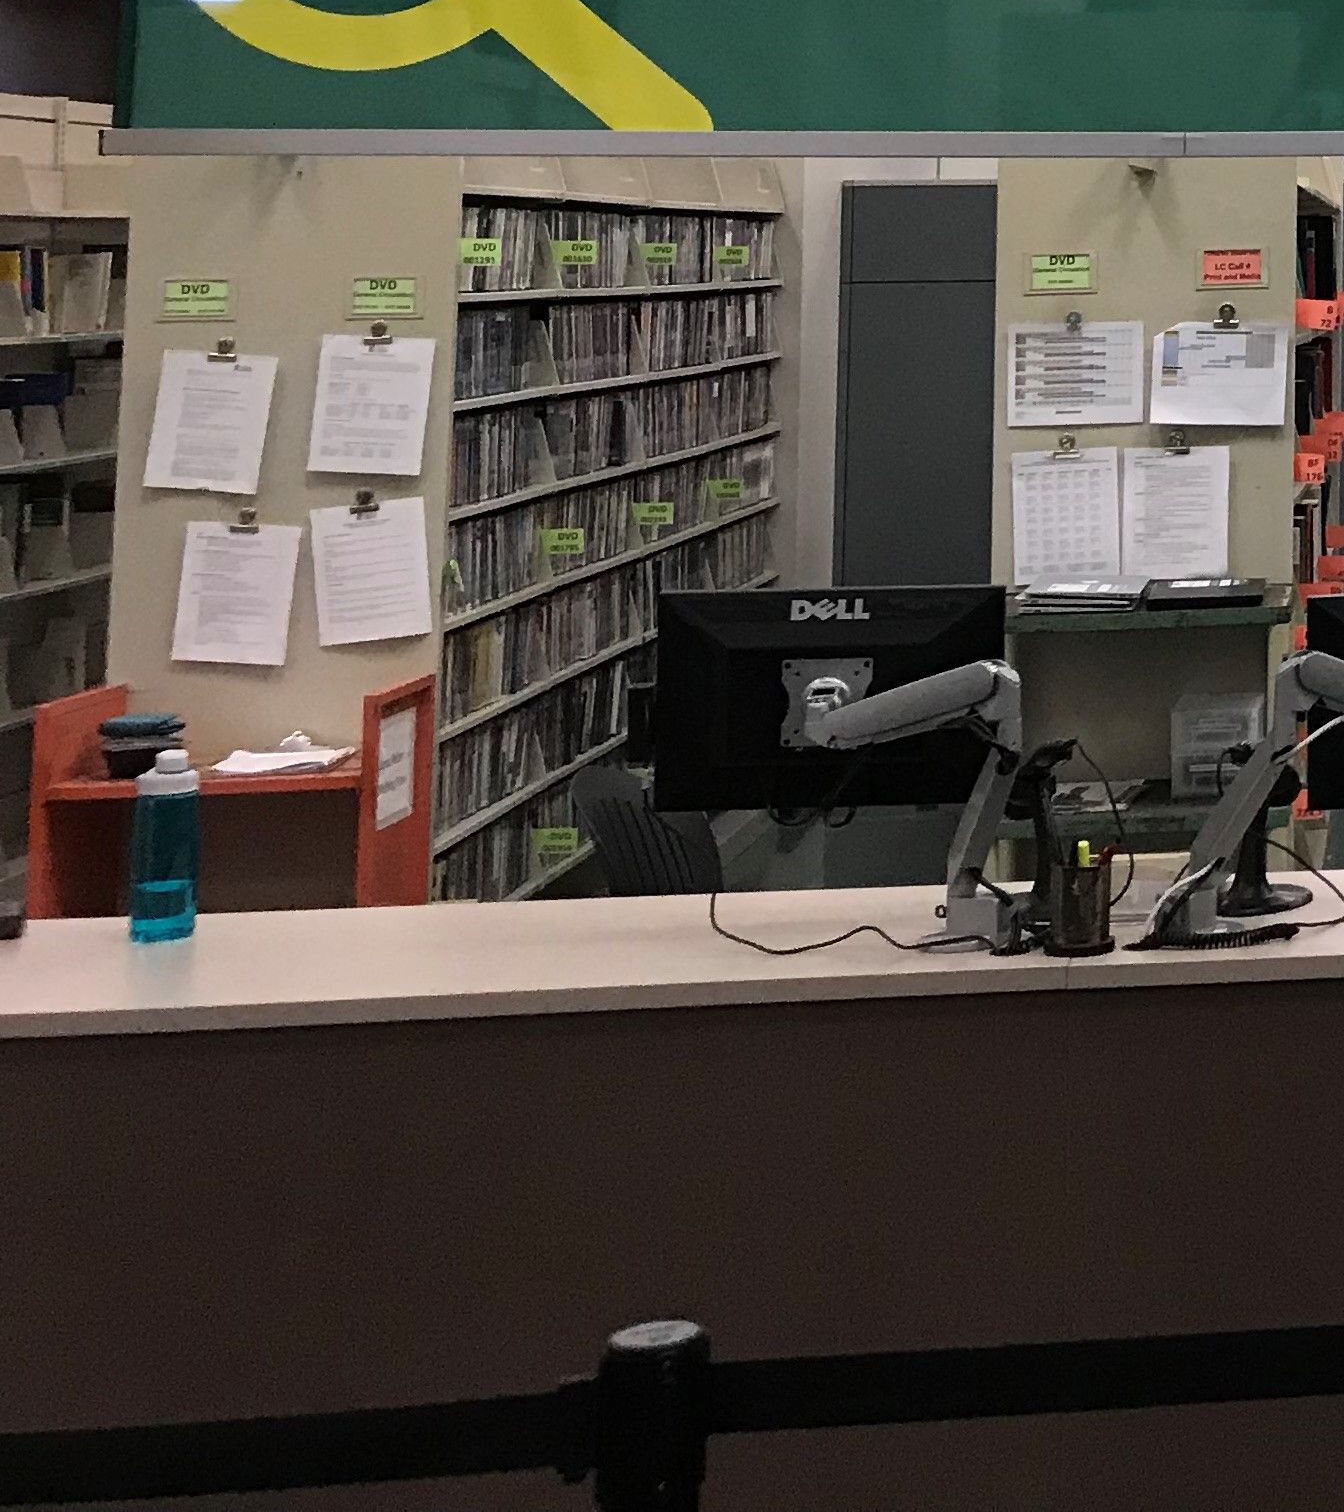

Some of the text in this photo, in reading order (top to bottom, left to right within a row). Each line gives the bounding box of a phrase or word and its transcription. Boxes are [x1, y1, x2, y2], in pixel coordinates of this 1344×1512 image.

[473, 243, 496, 252] DVD
[571, 243, 593, 252] DVD
[1050, 255, 1075, 266] DVD
[181, 284, 210, 295] DVD
[369, 279, 397, 290] DVD
[1321, 319, 1332, 328] 72
[558, 532, 578, 540] DVD
[790, 598, 870, 621] DELL
